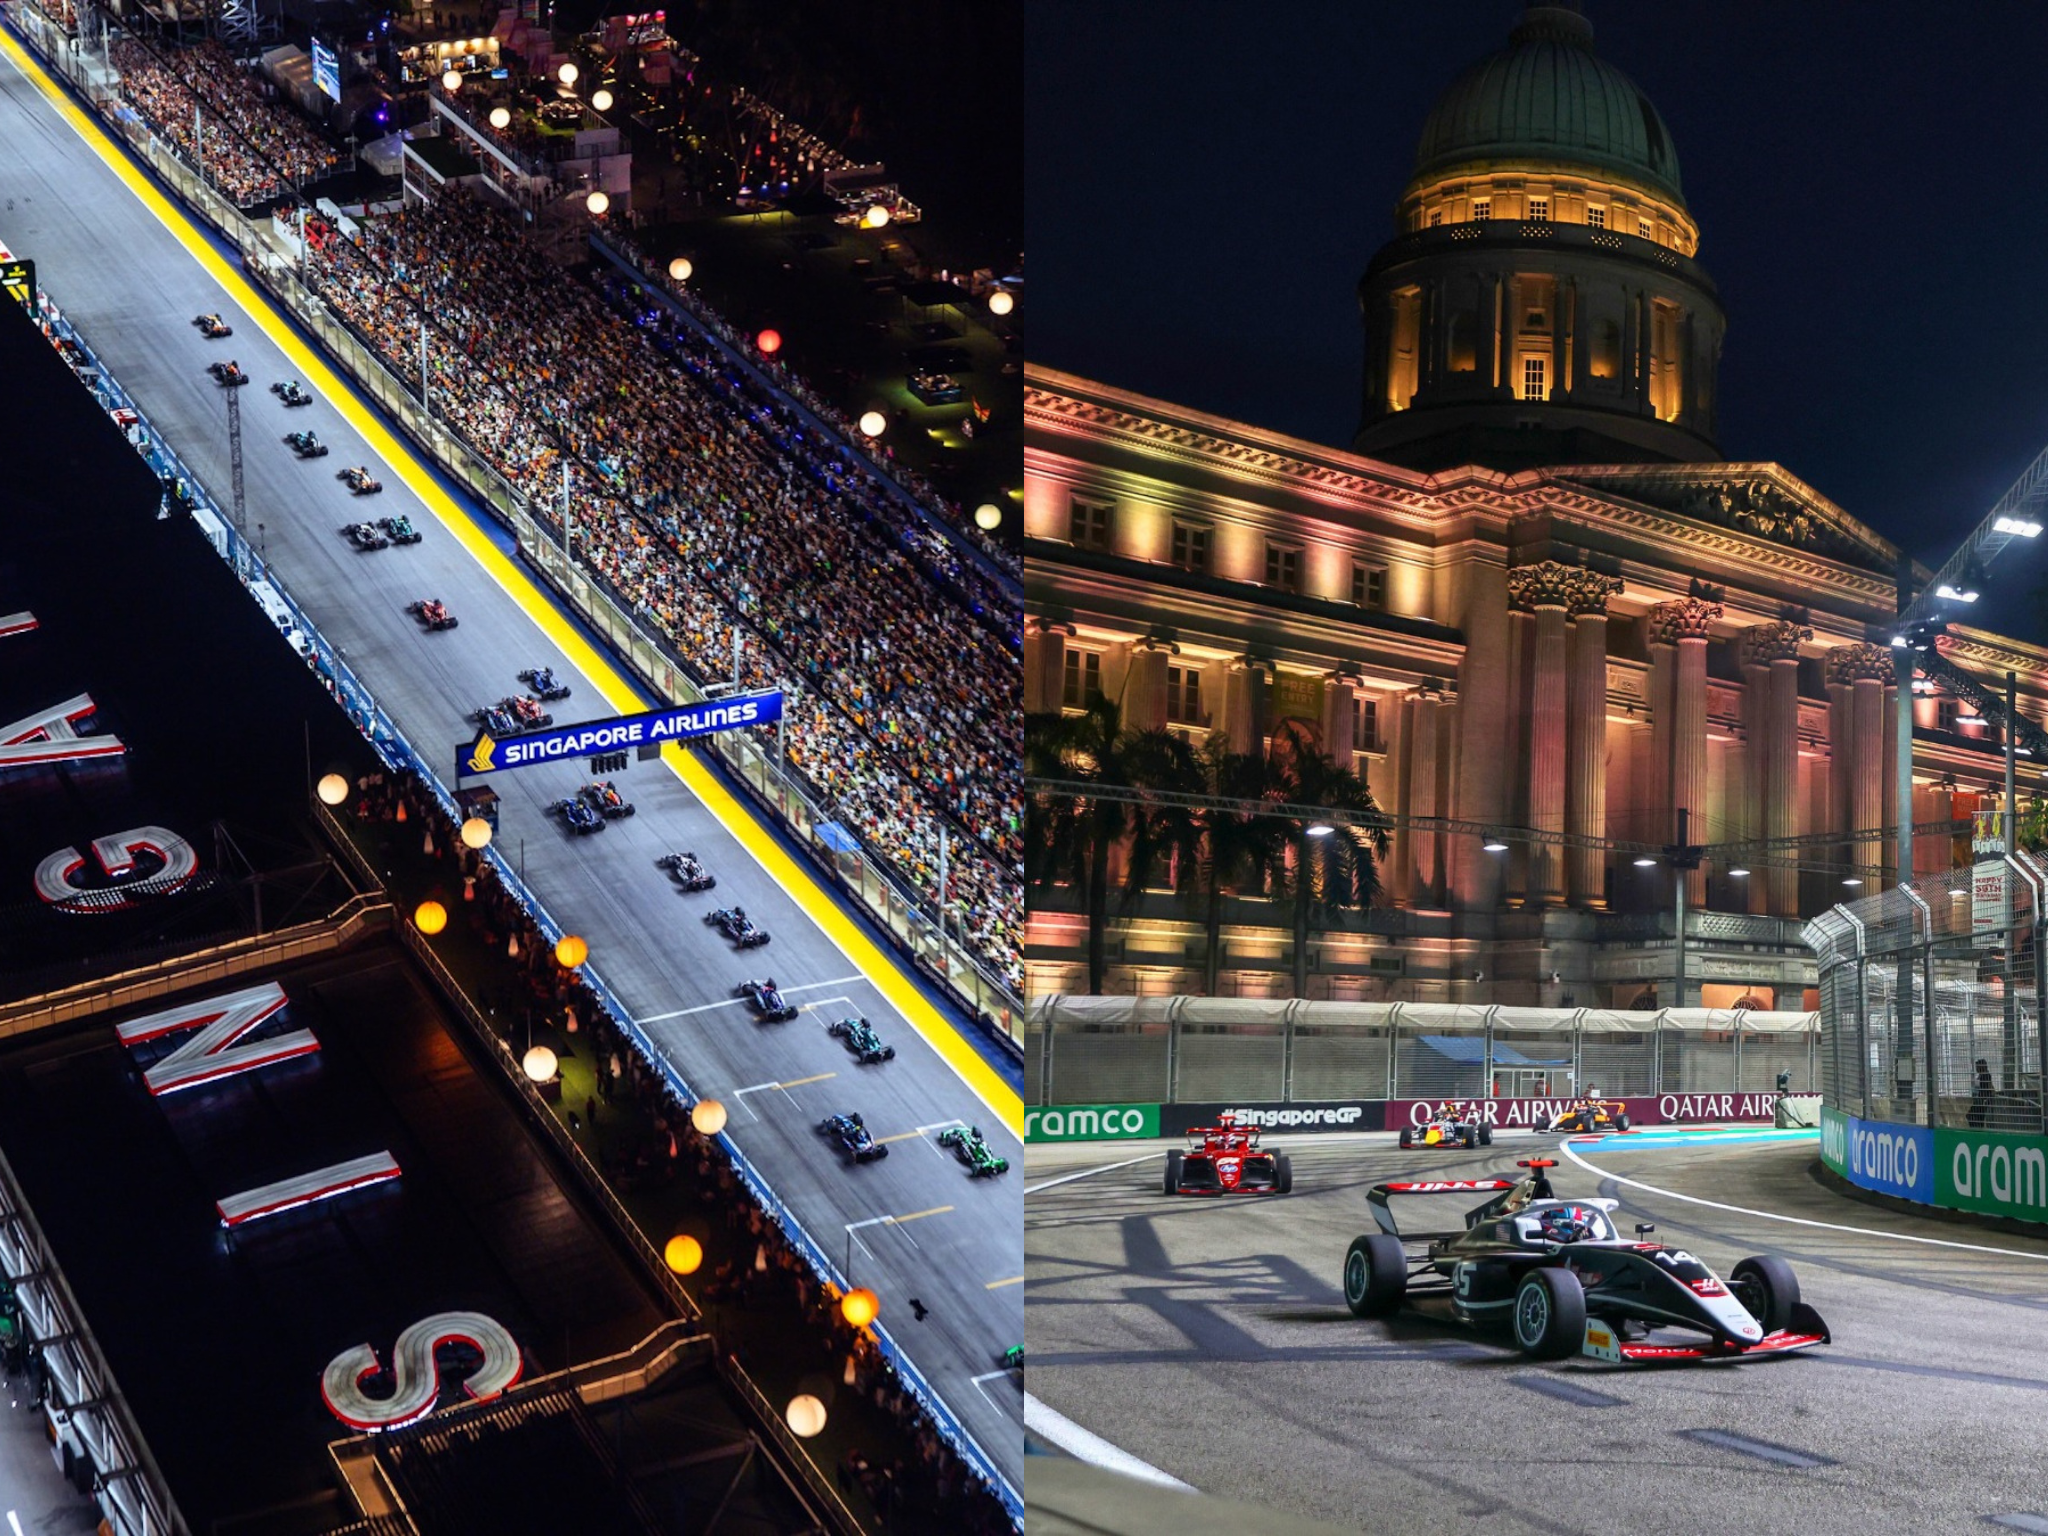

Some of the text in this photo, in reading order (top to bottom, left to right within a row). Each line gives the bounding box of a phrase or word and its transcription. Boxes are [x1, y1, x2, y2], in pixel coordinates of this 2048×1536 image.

[505, 702, 758, 763] SINGAPORE AIRLINES
[0, 611, 524, 1433] SINGA
[1024, 1109, 1144, 1137] ramco
[1505, 1100, 1607, 1124] AIRW
[1660, 1095, 1734, 1119] QATAR
[1852, 1129, 1917, 1188] aramco
[1953, 1142, 2046, 1207] aram
[1655, 1251, 1699, 1266] 14
